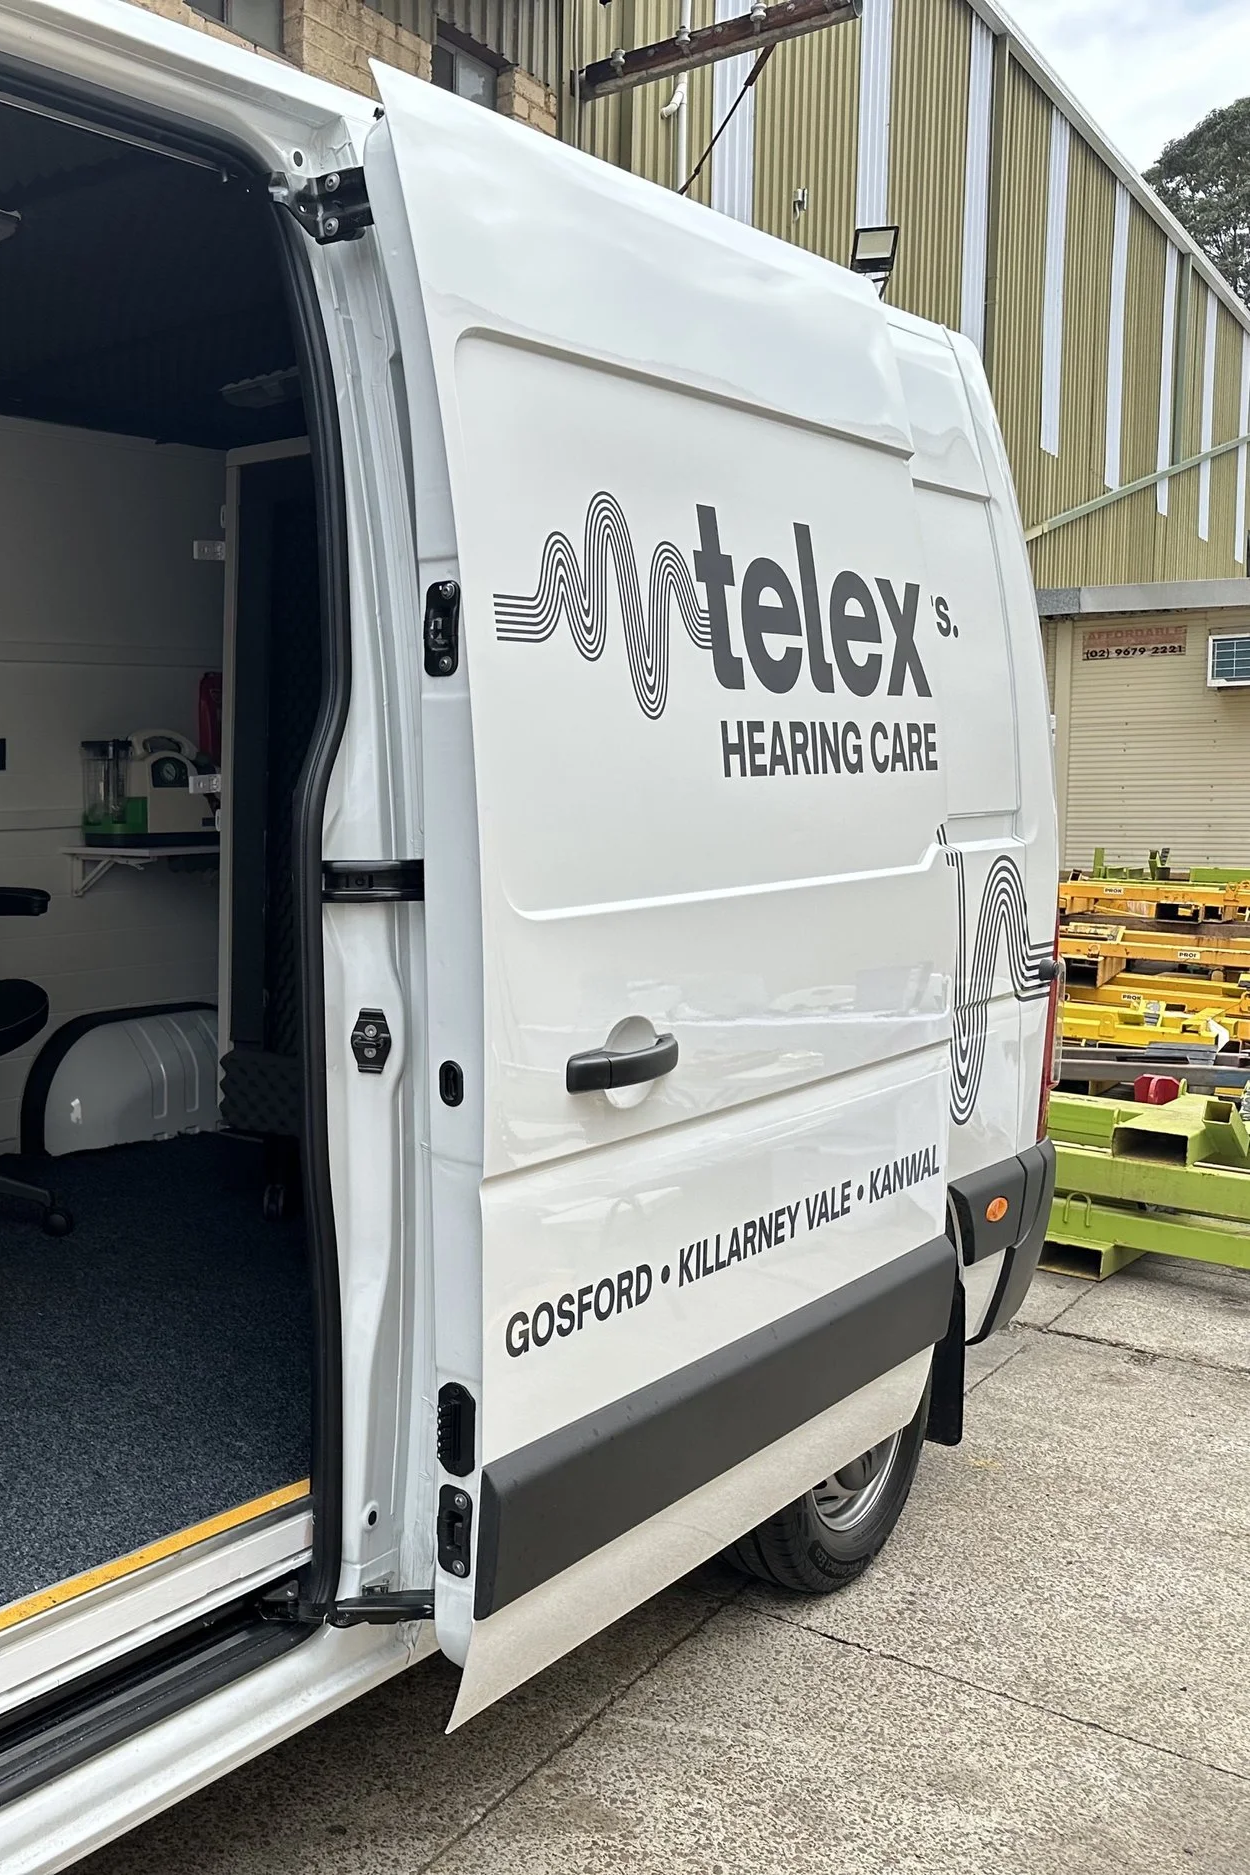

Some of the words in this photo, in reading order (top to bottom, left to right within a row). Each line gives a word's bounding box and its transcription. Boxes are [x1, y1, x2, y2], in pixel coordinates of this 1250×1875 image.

[693, 503, 933, 698] telex
[1086, 648, 1110, 660] (02)
[1114, 647, 1146, 657] 9679
[1151, 645, 1182, 654] 2221
[720, 719, 864, 779] HEARING
[869, 720, 939, 774] CARE
[505, 1263, 653, 1358] GOSFORD
[678, 1201, 801, 1288] KILLARNEY
[804, 1179, 852, 1232] VALE
[868, 1144, 940, 1204] KANWAL
